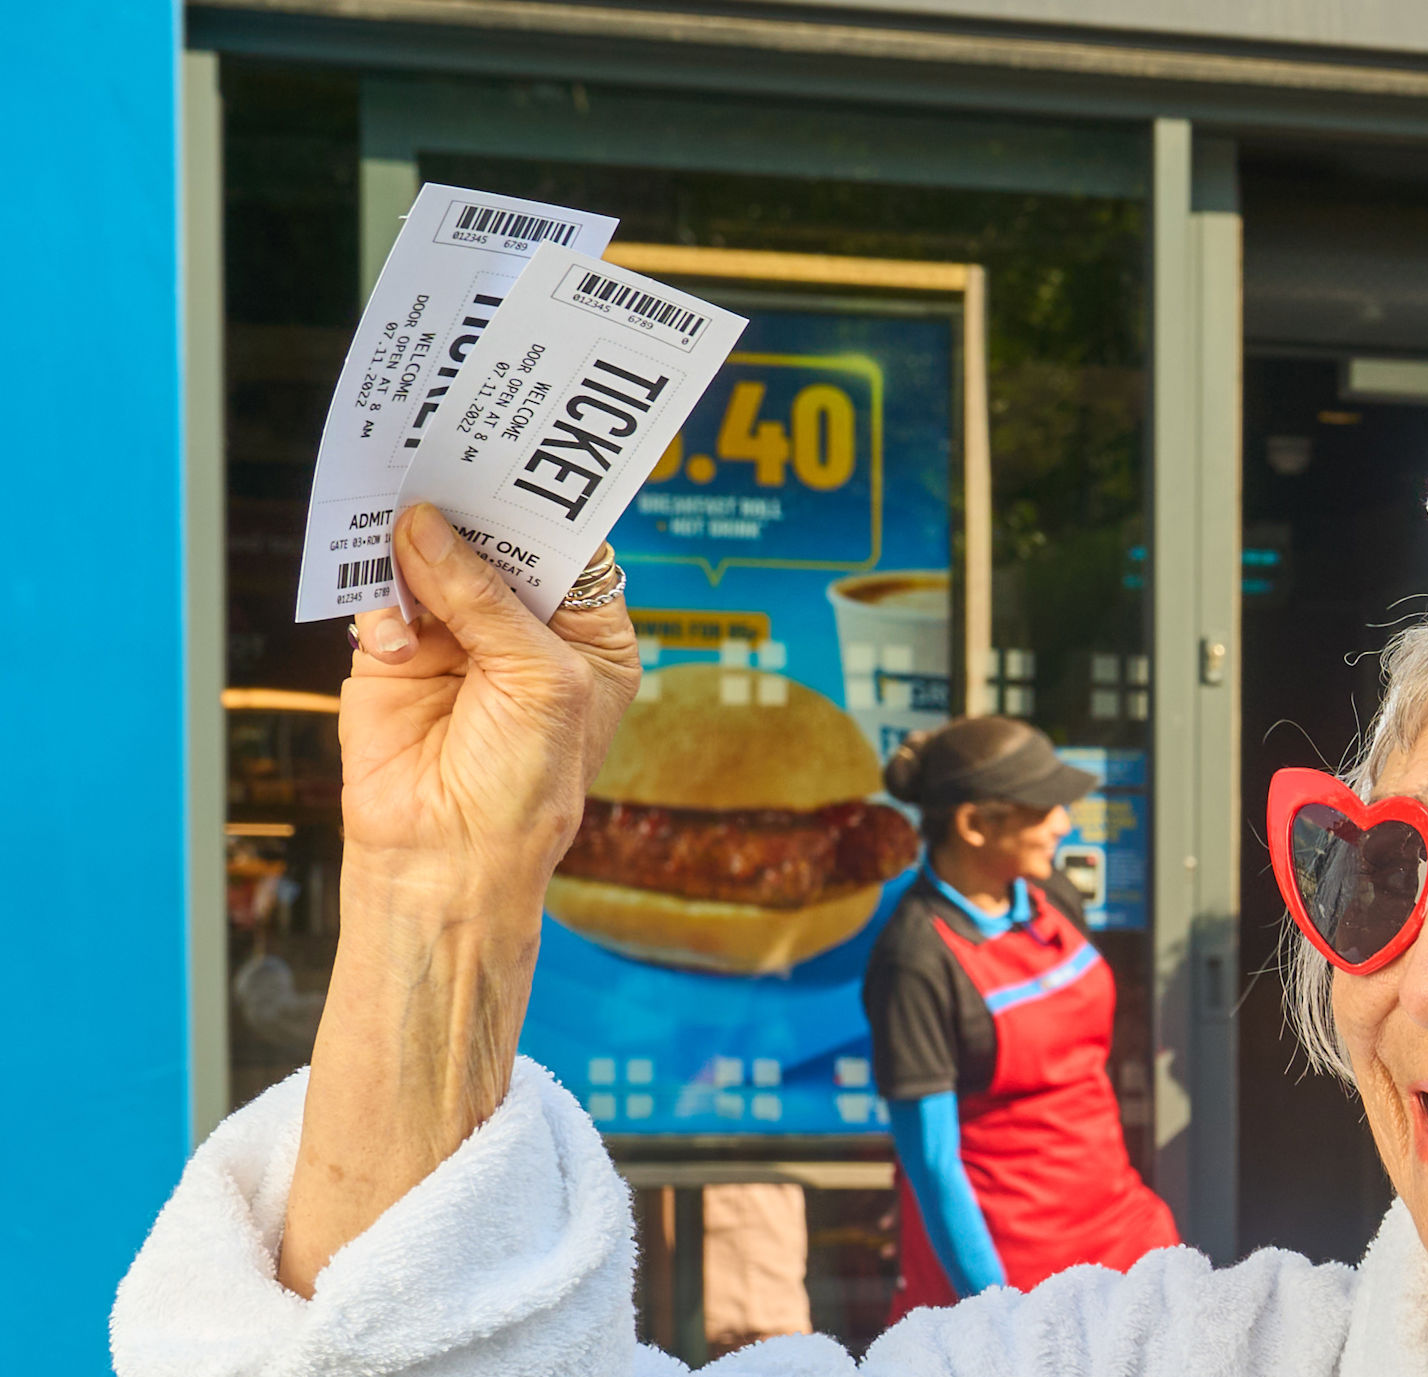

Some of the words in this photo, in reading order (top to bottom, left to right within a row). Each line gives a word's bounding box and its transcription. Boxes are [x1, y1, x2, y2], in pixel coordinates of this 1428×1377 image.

[452, 231, 488, 244] 012345
[503, 239, 528, 251] 6789
[404, 294, 429, 327] DOOR
[573, 293, 611, 313] 012345
[627, 315, 654, 329] 6789
[681, 337, 689, 345] 0
[355, 322, 398, 408] 07.11.2022
[386, 335, 410, 369] OPEN
[392, 331, 436, 403] WELCOME
[517, 343, 546, 373] DOOR
[377, 377, 391, 395] AT
[457, 362, 510, 433] 07.11.2022
[499, 377, 523, 408] OPEN
[370, 403, 381, 411] 8
[483, 411, 500, 428] AT
[501, 381, 552, 442] WELCOME
[360, 419, 374, 438] AM
[474, 432, 488, 441] 8
[513, 359, 670, 522] TICKET
[460, 445, 479, 462] AM
[349, 509, 394, 530] ADMIT
[330, 539, 348, 551] GATE
[453, 524, 495, 545] MIT
[496, 541, 540, 568] ONE
[526, 576, 542, 587] 15
